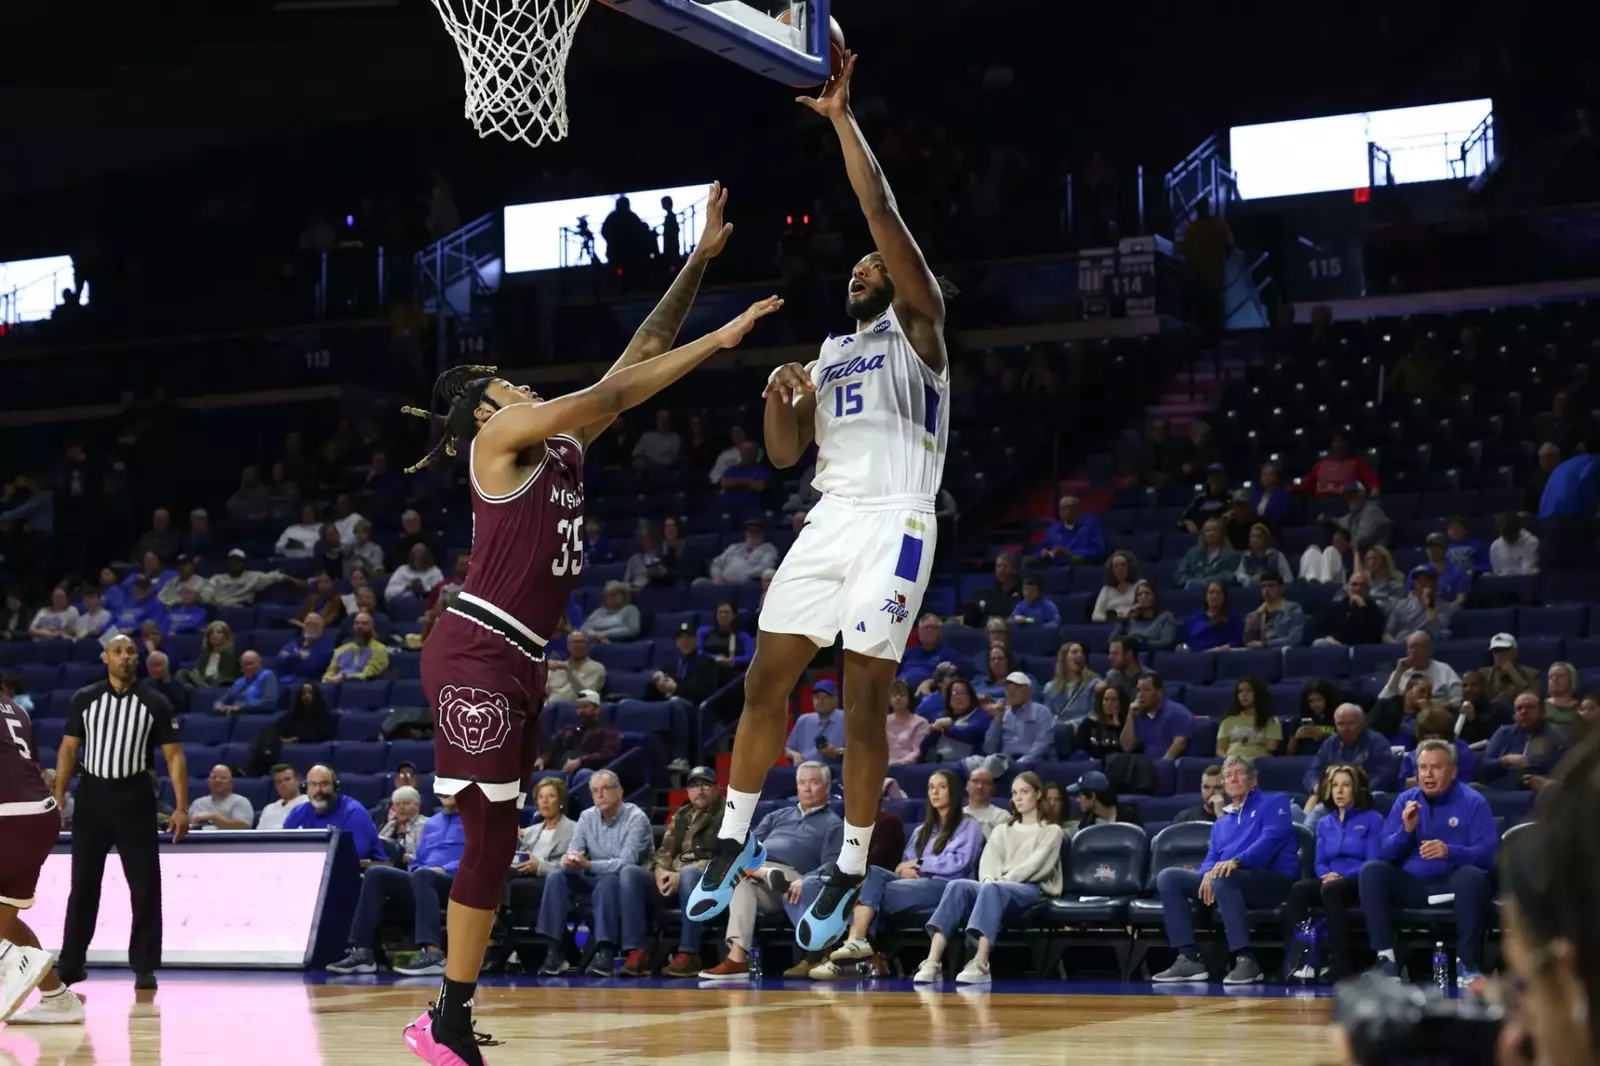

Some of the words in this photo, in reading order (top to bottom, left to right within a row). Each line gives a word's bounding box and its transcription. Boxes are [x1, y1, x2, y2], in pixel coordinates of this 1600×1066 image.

[1308, 257, 1341, 278] 115
[1111, 275, 1143, 297] 114
[459, 335, 484, 354] 114
[817, 354, 886, 394] Tulsa
[835, 382, 863, 418] 15
[551, 515, 584, 577] 35
[880, 598, 910, 619] Tulsa
[4, 718, 32, 760] 5
